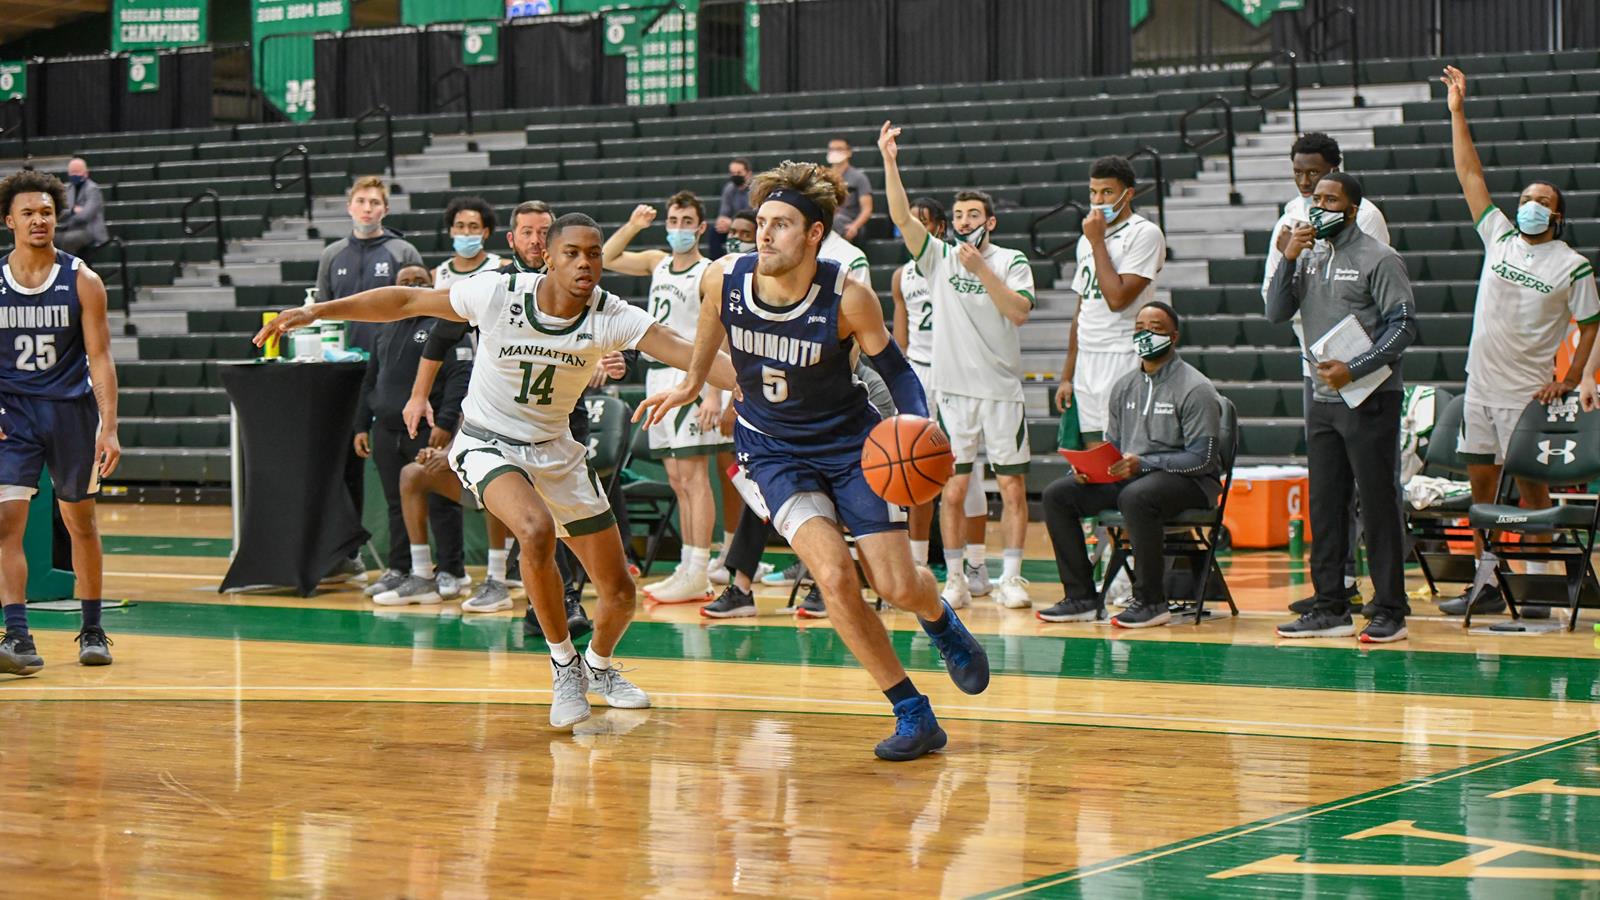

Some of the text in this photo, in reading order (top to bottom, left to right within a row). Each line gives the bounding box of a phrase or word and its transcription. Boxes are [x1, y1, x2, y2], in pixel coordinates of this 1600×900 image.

[121, 24, 200, 42] CHAMPIONS
[1081, 265, 1102, 299] 24
[1491, 264, 1553, 294] JASPERS
[0, 304, 70, 329] MONMOUTH
[14, 334, 57, 371] 25
[498, 345, 587, 368] MANHATTAN
[730, 324, 823, 368] MONMOUTH
[513, 361, 557, 405] 14
[761, 364, 790, 404] 5
[1287, 485, 1302, 515] G
